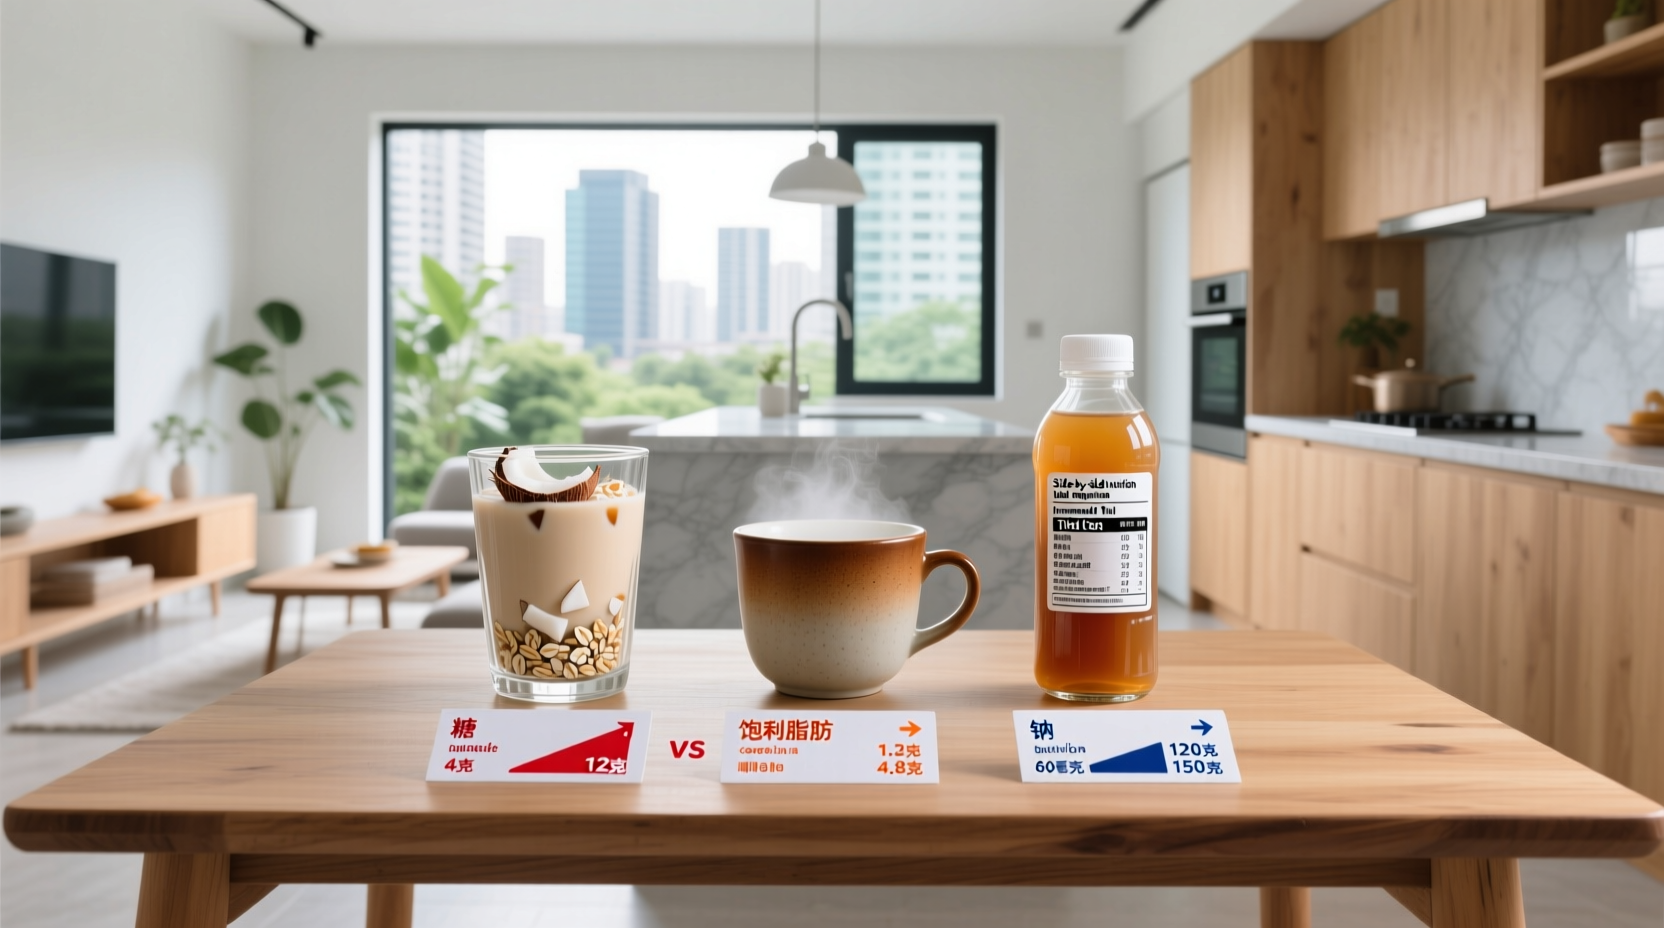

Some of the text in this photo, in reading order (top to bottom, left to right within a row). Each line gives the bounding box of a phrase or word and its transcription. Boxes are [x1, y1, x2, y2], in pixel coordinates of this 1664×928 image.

[450, 717, 477, 739] 糖
[739, 719, 833, 741] 饱利脂肪
[1030, 719, 1054, 740] 钠
[669, 740, 706, 759] VS
[878, 743, 921, 758] 1.2克
[1169, 742, 1219, 757] 120克
[444, 758, 475, 773] 4克
[585, 756, 627, 774] 12克
[876, 760, 923, 775] 4.8克
[1172, 759, 1224, 775] 150克
